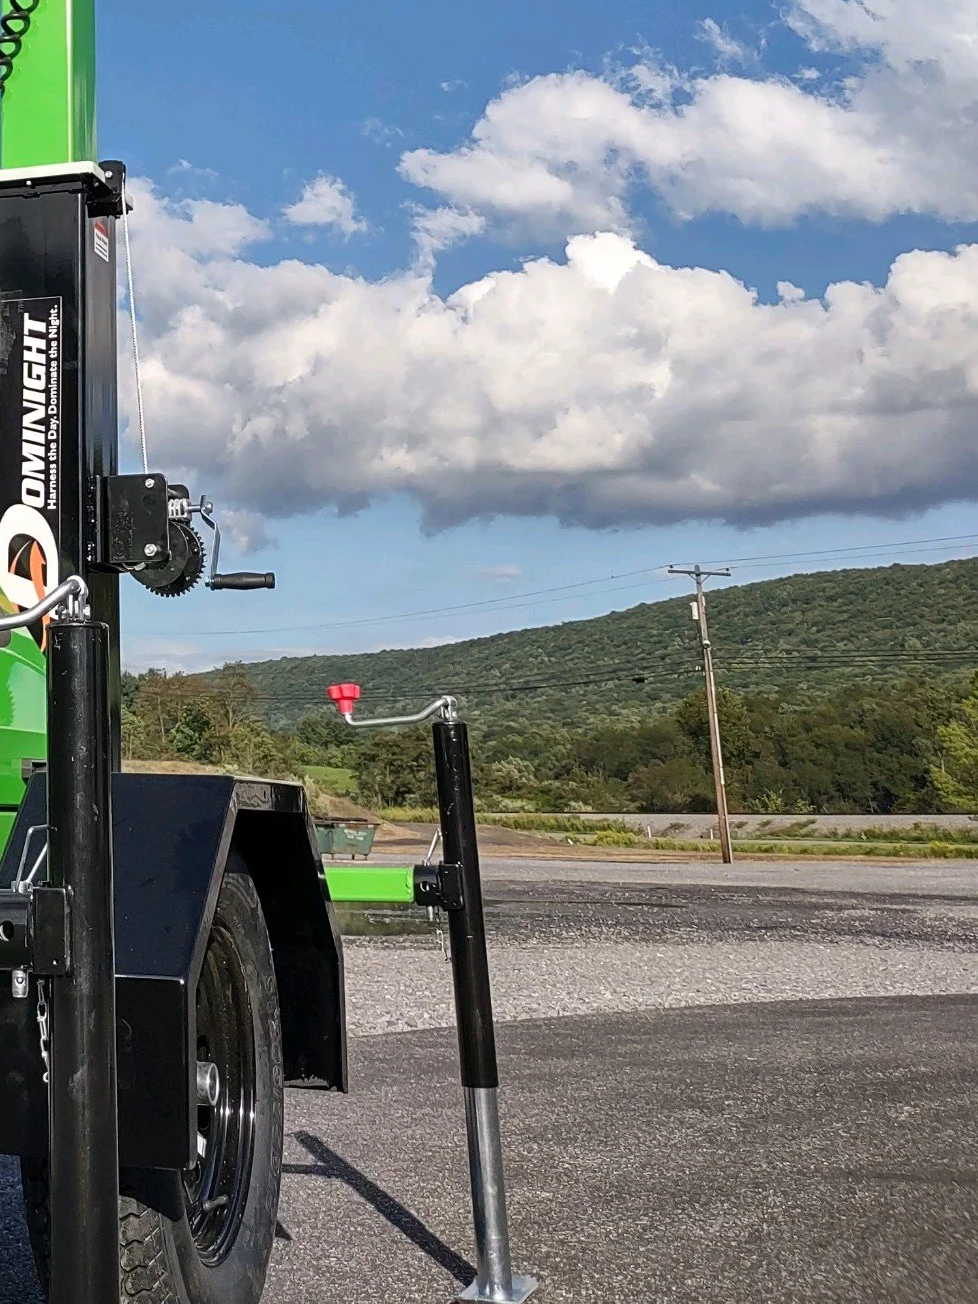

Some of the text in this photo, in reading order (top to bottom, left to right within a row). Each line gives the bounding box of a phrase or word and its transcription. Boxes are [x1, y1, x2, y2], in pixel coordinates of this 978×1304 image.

[47, 304, 60, 510] Harness the Day. Dominate the Night.
